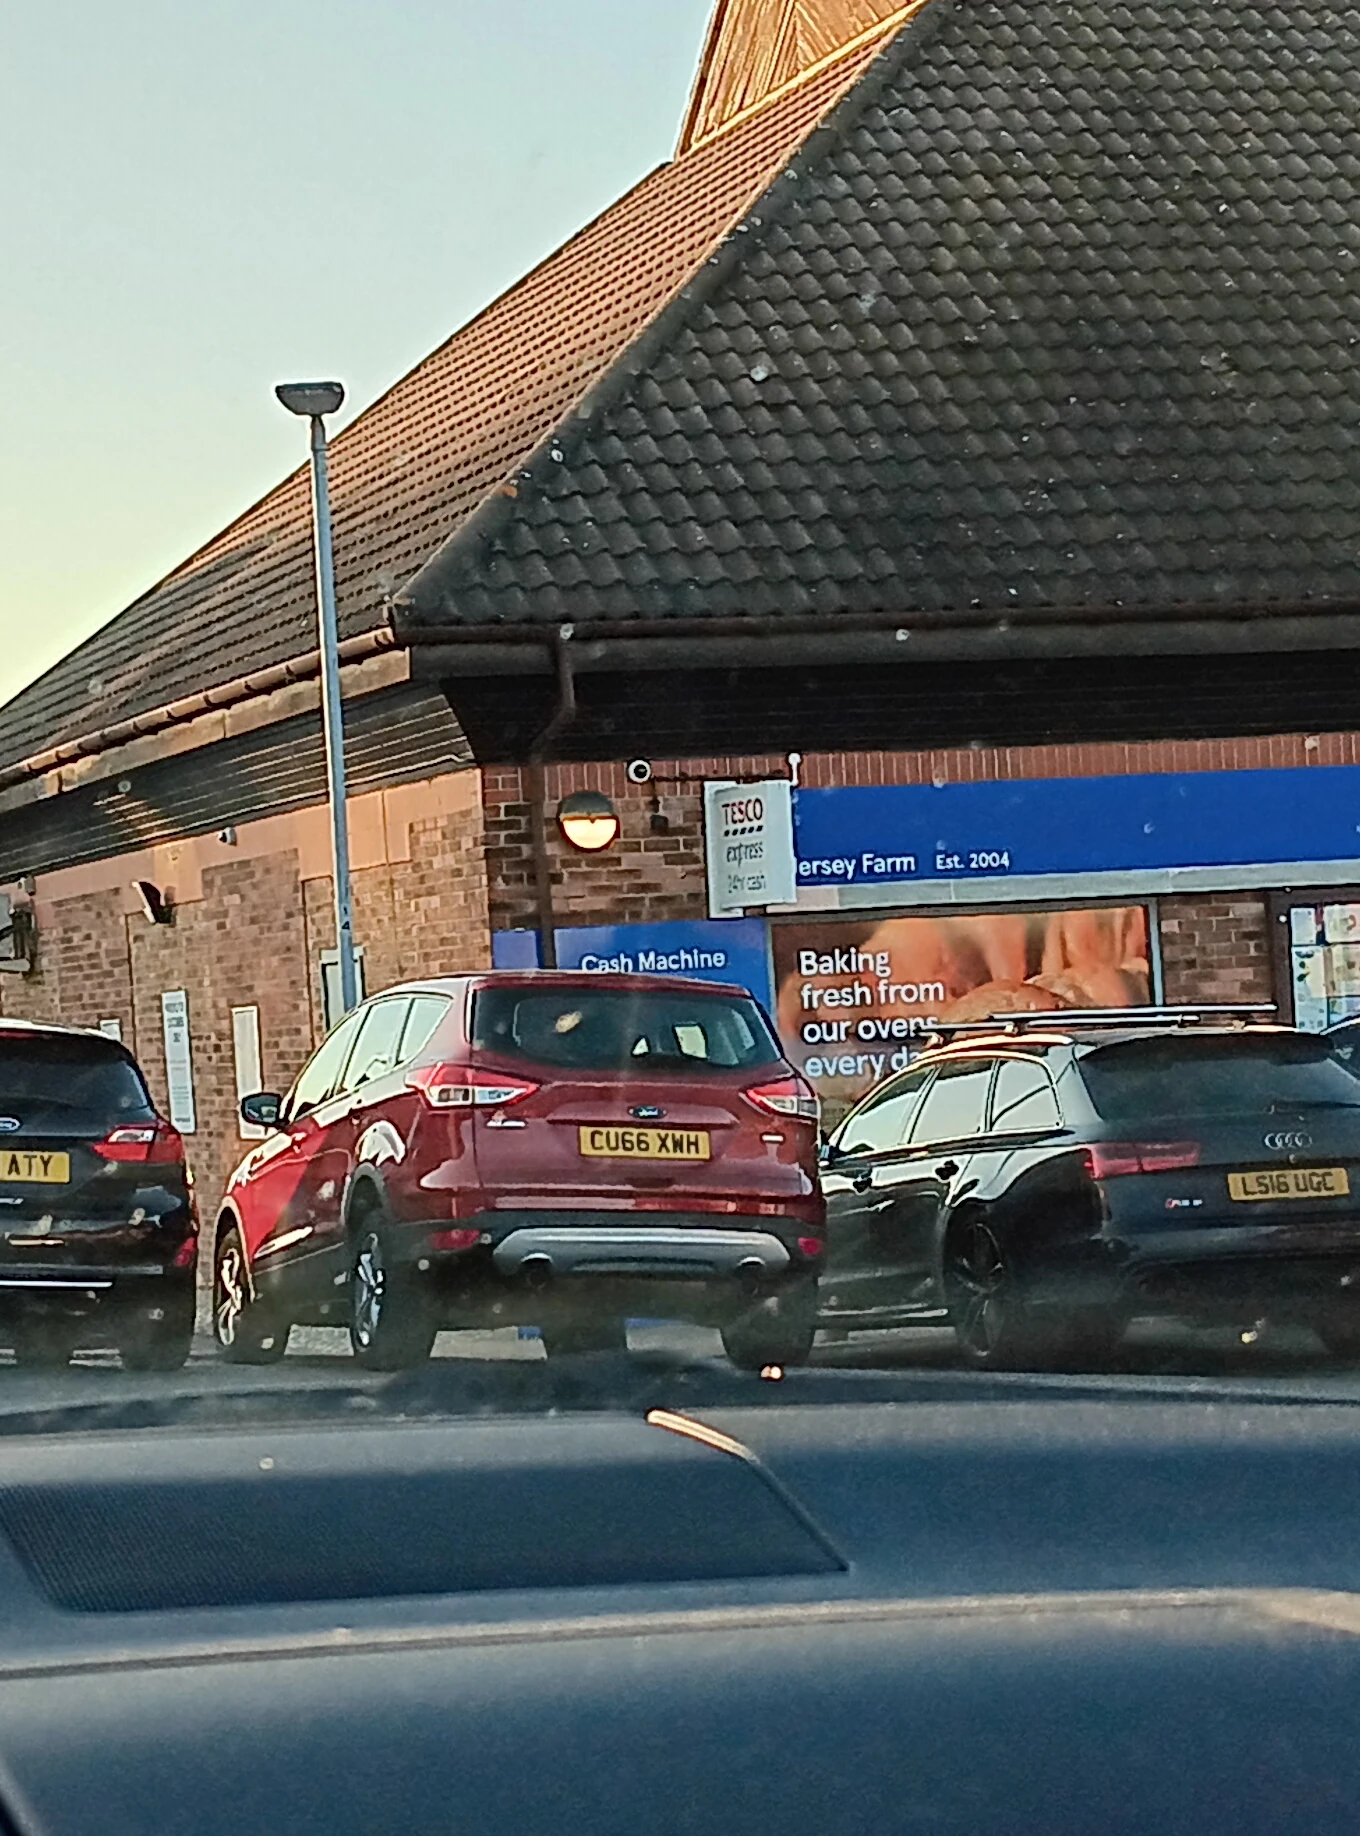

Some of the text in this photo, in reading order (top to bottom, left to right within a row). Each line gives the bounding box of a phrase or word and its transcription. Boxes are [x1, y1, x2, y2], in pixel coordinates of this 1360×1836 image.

[722, 798, 763, 825] TESCO
[797, 851, 1010, 880] ersey Farm Est. 2004
[582, 949, 725, 973] Cash Machine
[800, 947, 891, 978] Baking
[801, 979, 944, 1009] fresh from
[803, 1020, 852, 1043] our
[805, 1053, 885, 1081] every
[591, 1130, 700, 1154] CU66 XWH
[7, 1154, 53, 1177] ATY
[1241, 1171, 1335, 1196] LS16 UGC
